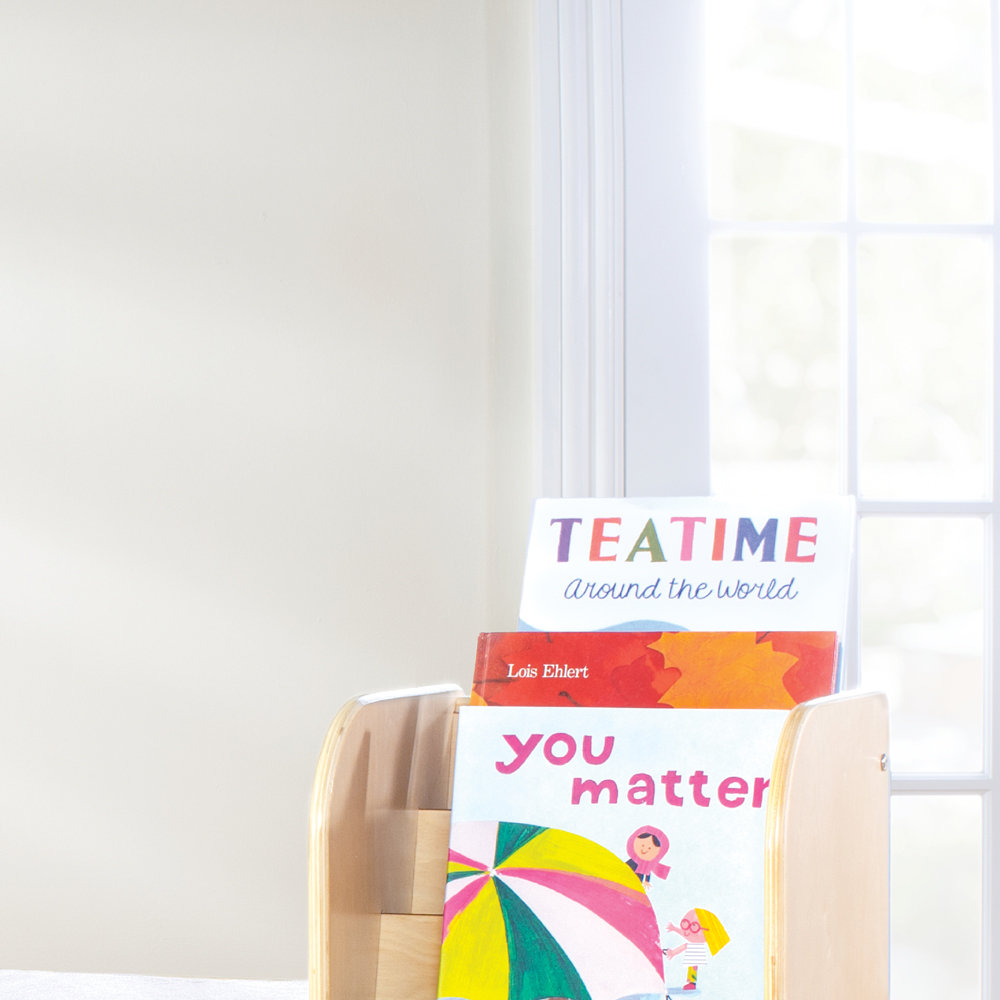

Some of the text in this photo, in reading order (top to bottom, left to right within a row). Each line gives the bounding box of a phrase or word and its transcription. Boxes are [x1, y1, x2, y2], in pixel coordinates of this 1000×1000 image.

[550, 516, 818, 563] TEATIME
[668, 577, 713, 600] the
[507, 663, 590, 680] Lois Ehlert
[495, 732, 615, 774] you
[571, 770, 770, 808] matter
